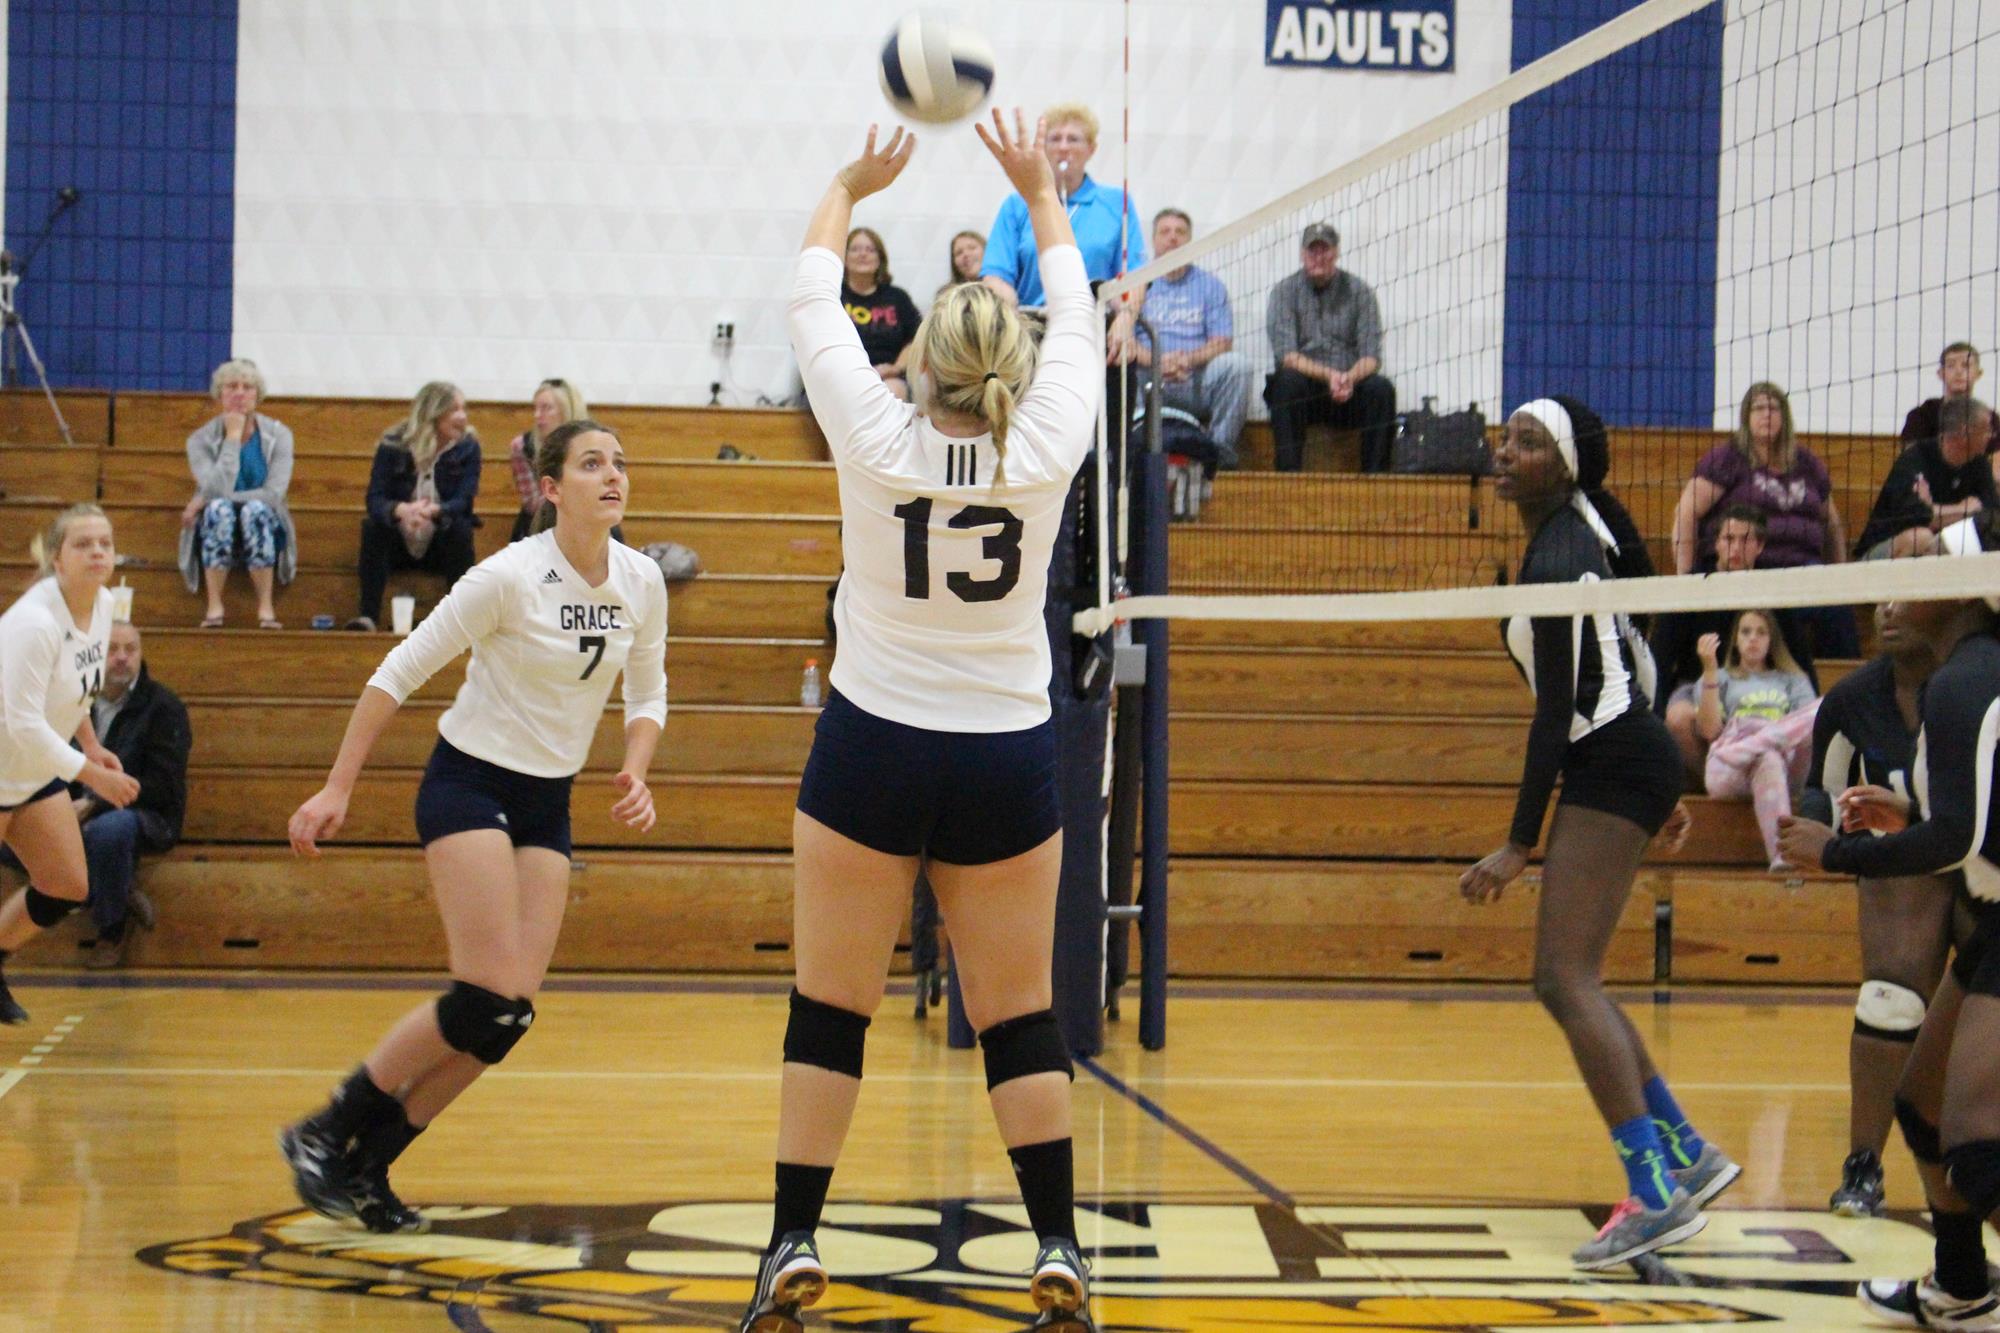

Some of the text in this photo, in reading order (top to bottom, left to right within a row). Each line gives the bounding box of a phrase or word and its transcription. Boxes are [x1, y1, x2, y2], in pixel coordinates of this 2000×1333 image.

[1271, 6, 1449, 66] ADULTS
[894, 496, 1024, 603] 13
[560, 604, 622, 630] GRACE
[75, 640, 103, 672] GRACE
[579, 635, 606, 681] 7
[79, 667, 101, 705] 14
